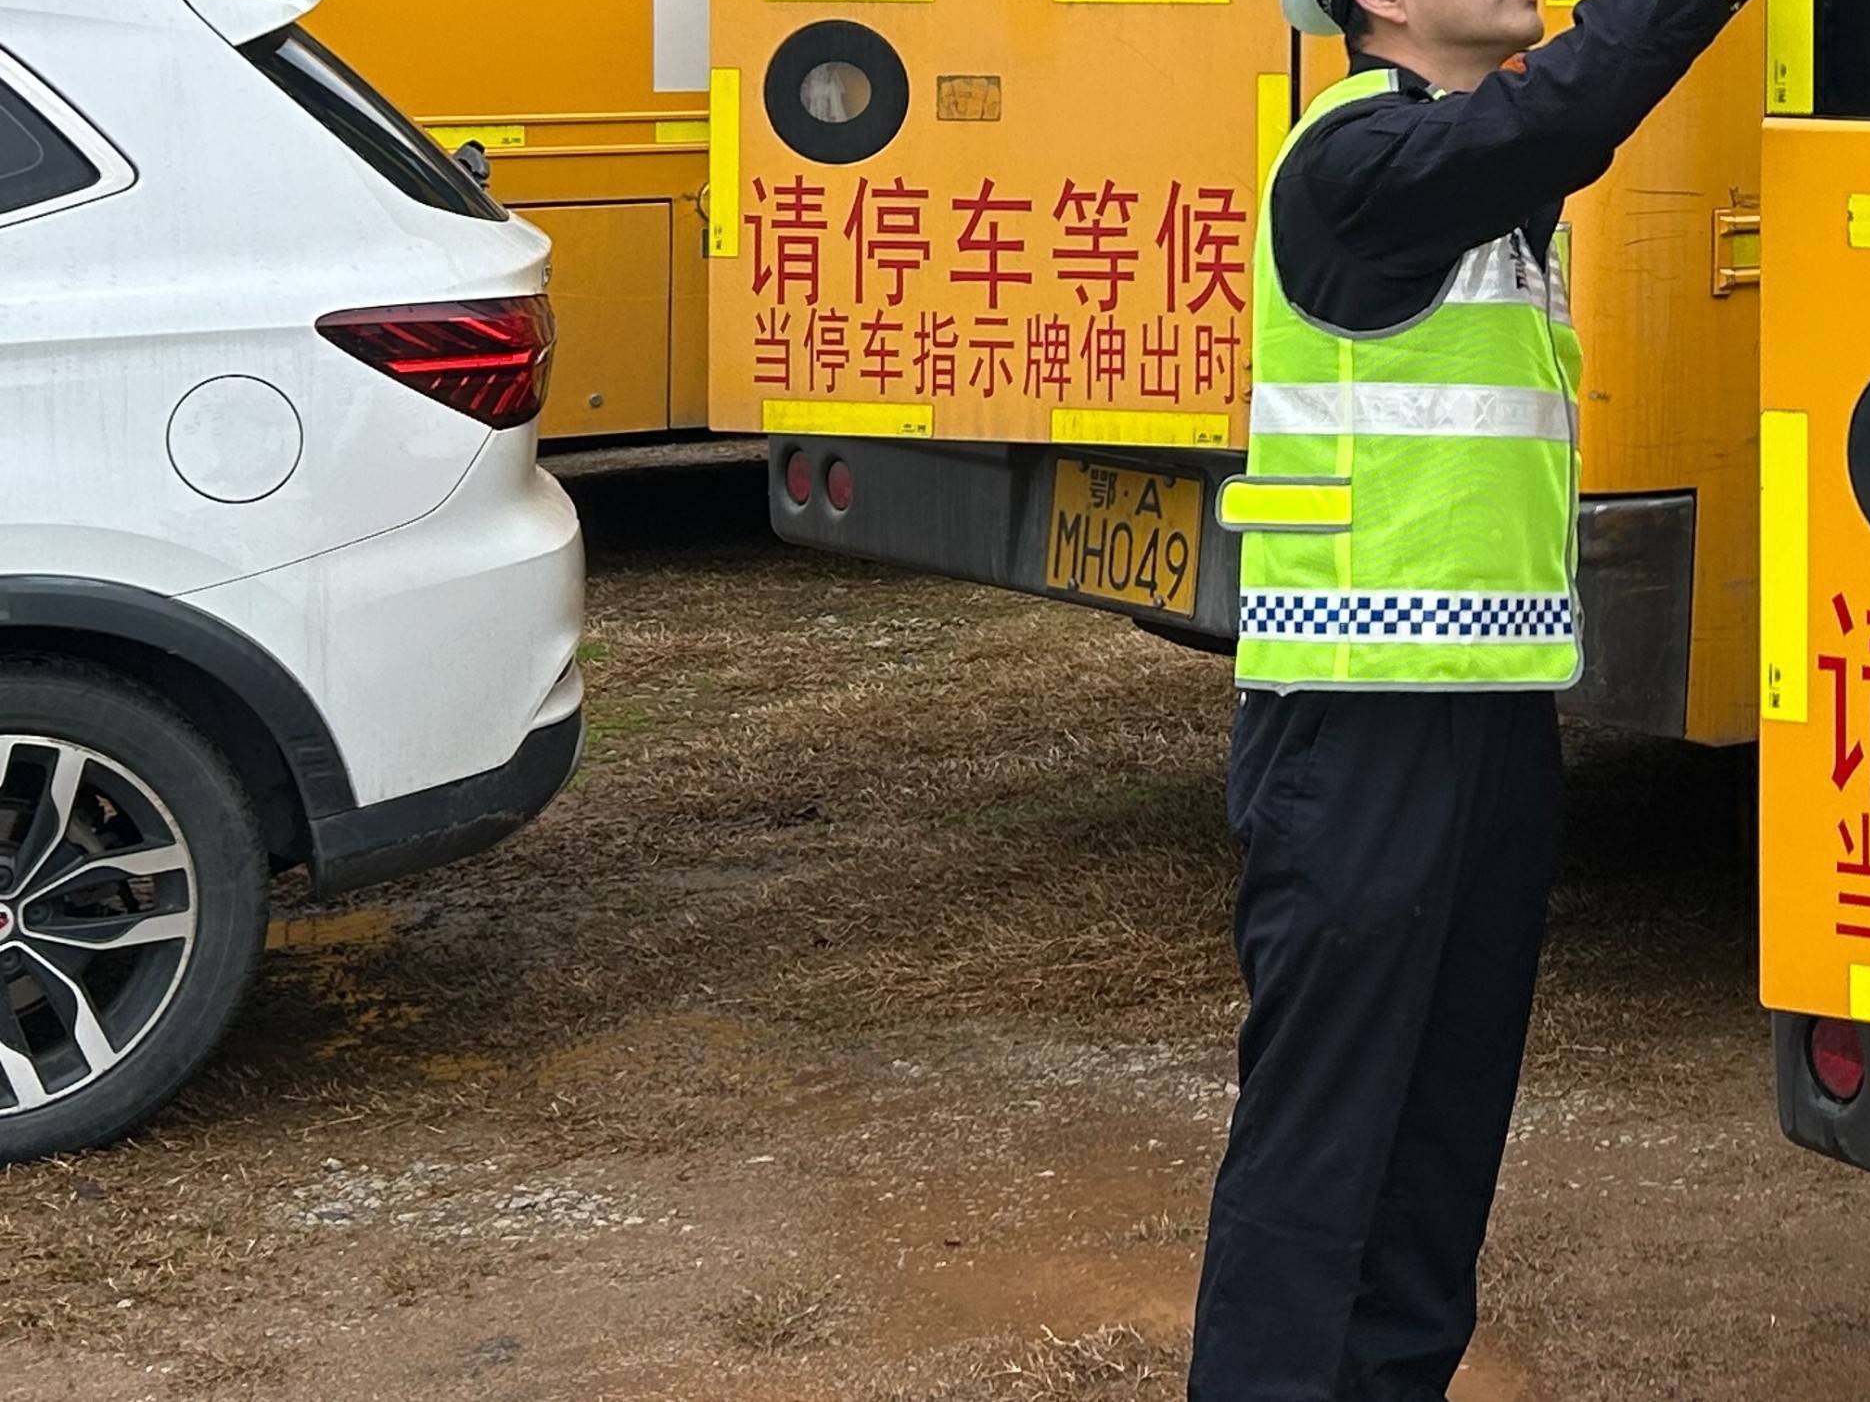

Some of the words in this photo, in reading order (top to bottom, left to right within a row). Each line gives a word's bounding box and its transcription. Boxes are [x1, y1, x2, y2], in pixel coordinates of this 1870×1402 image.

[743, 174, 1247, 315] 请停车等候
[753, 306, 1241, 405] 当停车指示牌伸出时
[1053, 509, 1189, 601] MH049
